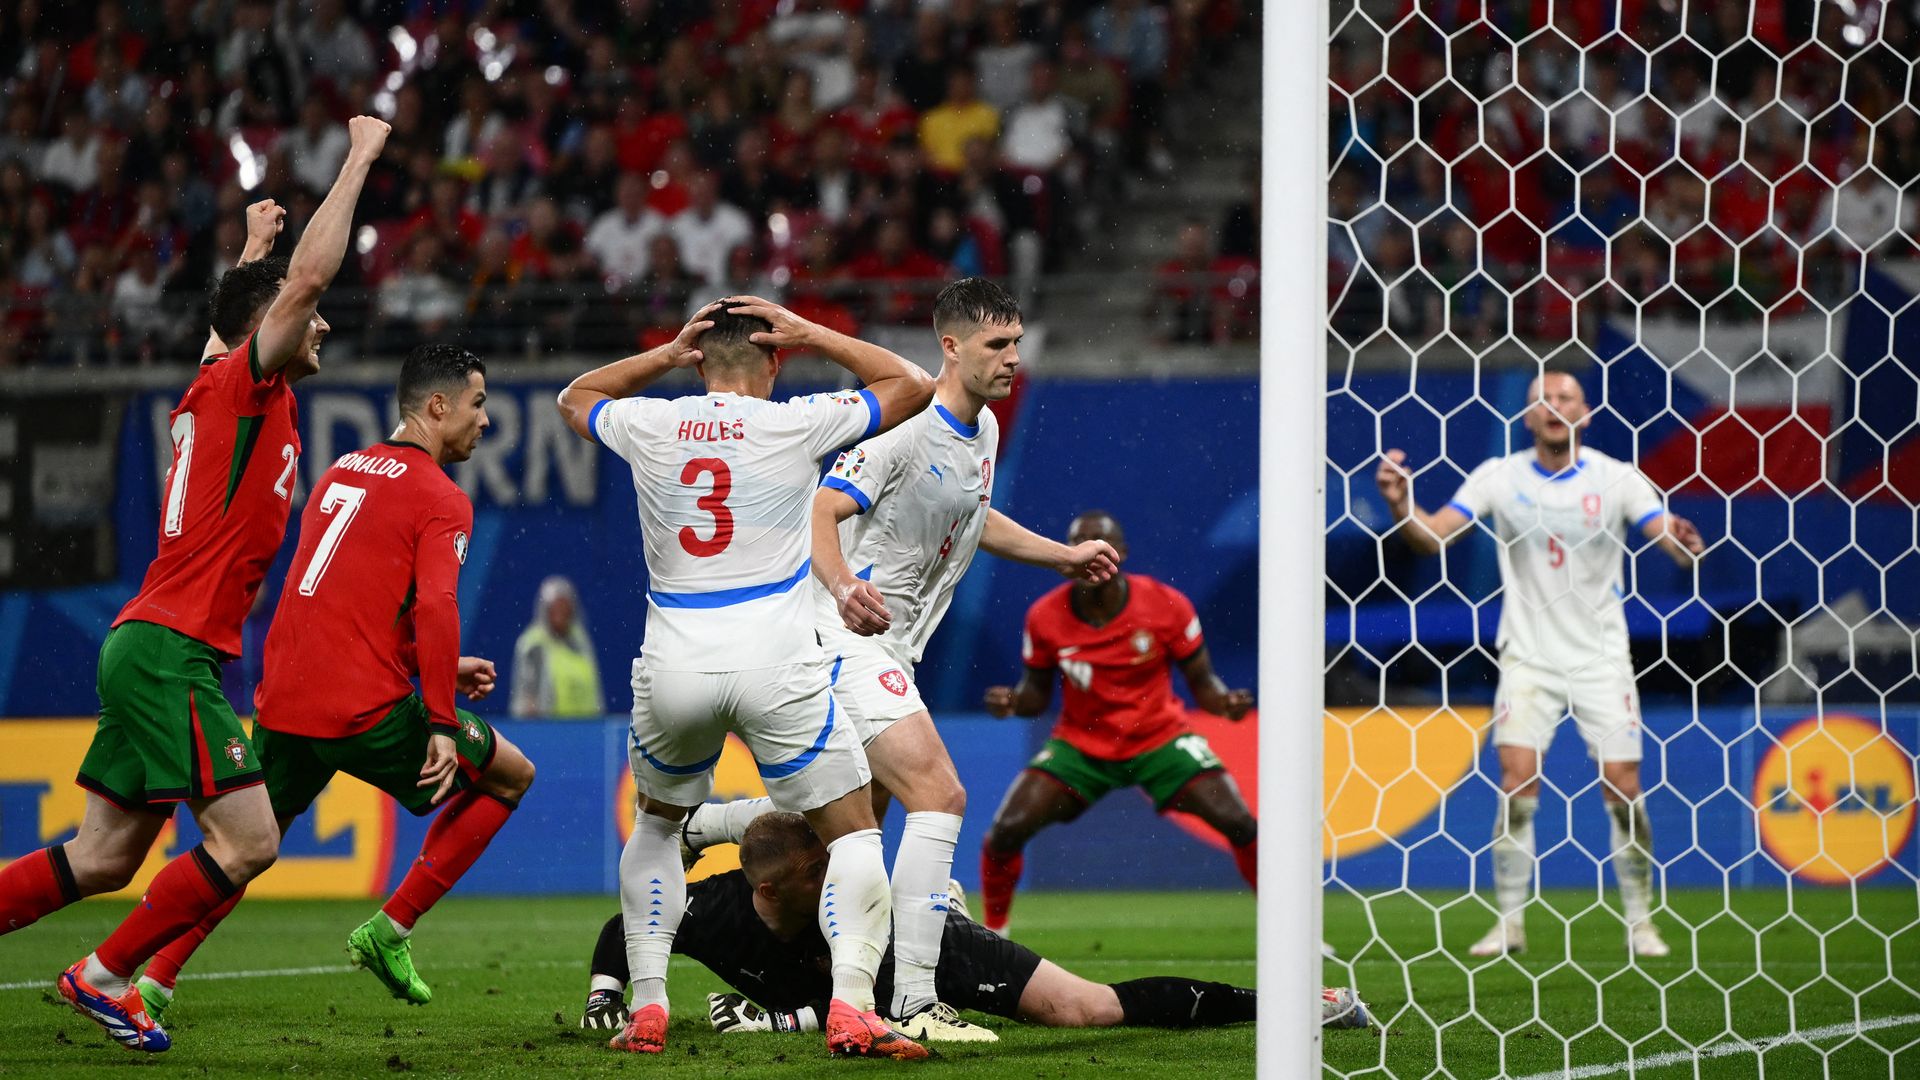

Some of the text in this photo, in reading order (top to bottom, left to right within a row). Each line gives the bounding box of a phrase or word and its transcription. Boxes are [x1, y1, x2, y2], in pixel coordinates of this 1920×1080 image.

[678, 418, 744, 442] HOLEŠ
[332, 452, 408, 479] RONALDO
[678, 457, 734, 558] 3
[298, 481, 367, 597] 7
[1547, 532, 1565, 569] 5
